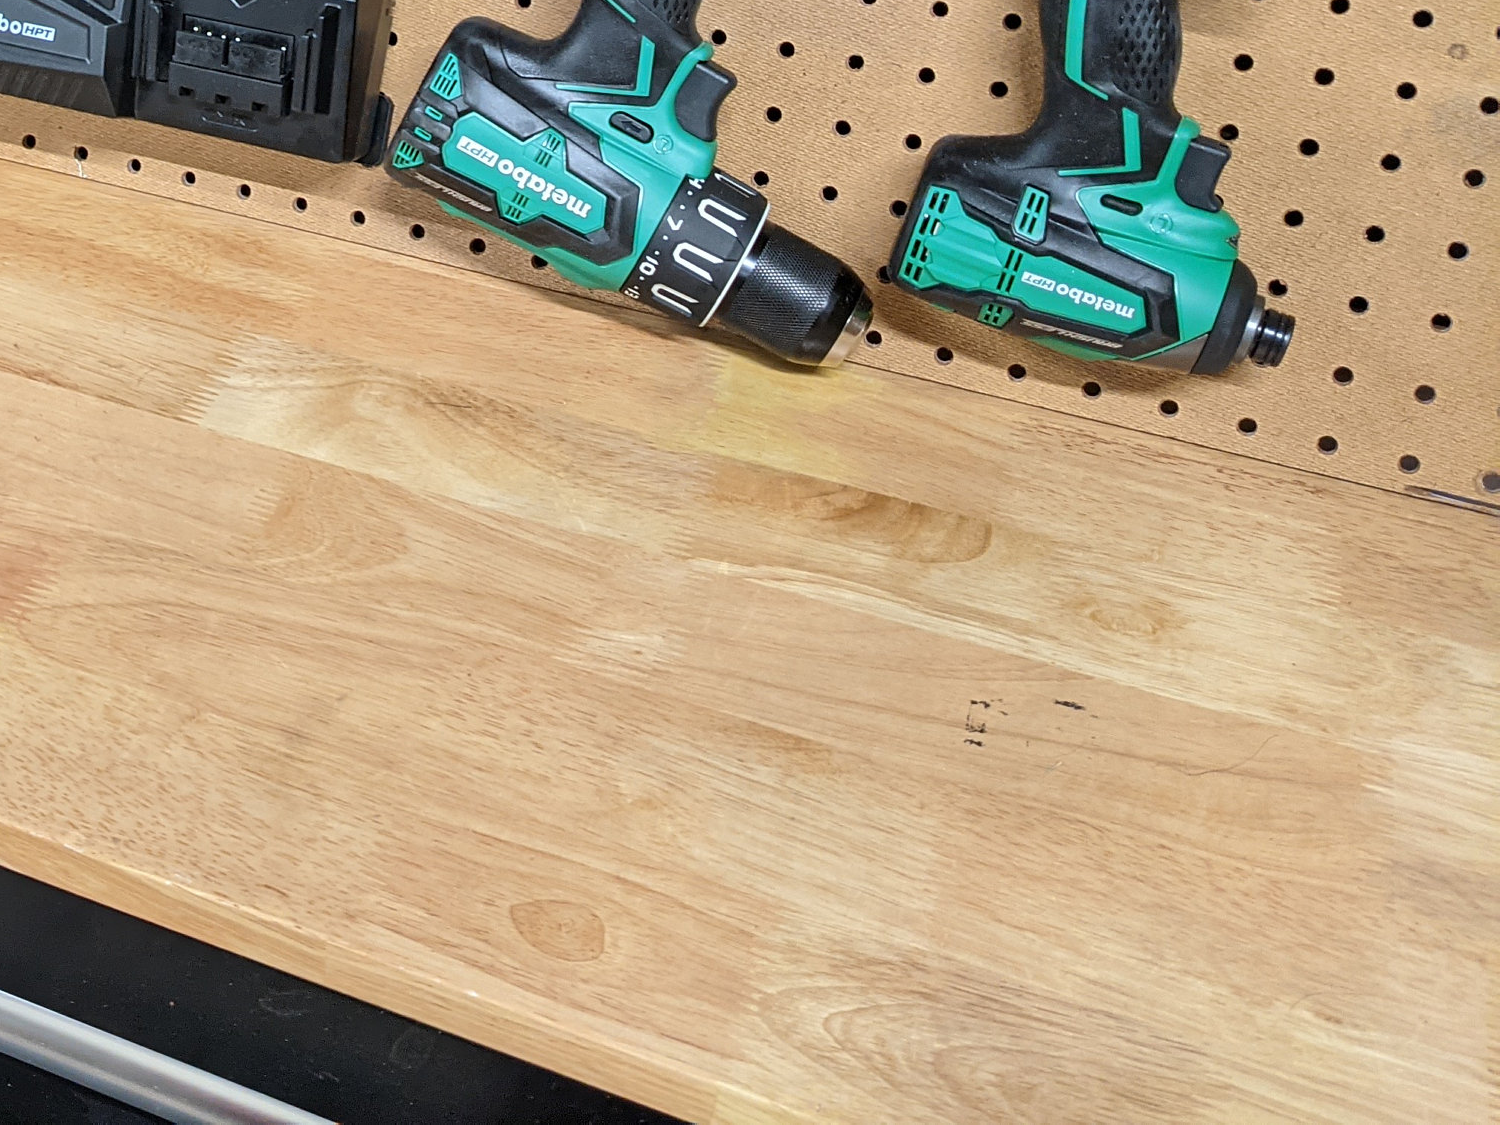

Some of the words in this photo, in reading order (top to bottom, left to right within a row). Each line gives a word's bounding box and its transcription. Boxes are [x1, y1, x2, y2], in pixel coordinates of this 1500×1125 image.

[24, 24, 54, 40] HPT
[458, 138, 497, 165] HPT
[498, 159, 592, 218] metabo
[667, 215, 684, 231] 7
[639, 255, 659, 276] 10
[1023, 273, 1054, 290] HPT
[1056, 284, 1135, 318] metabo
